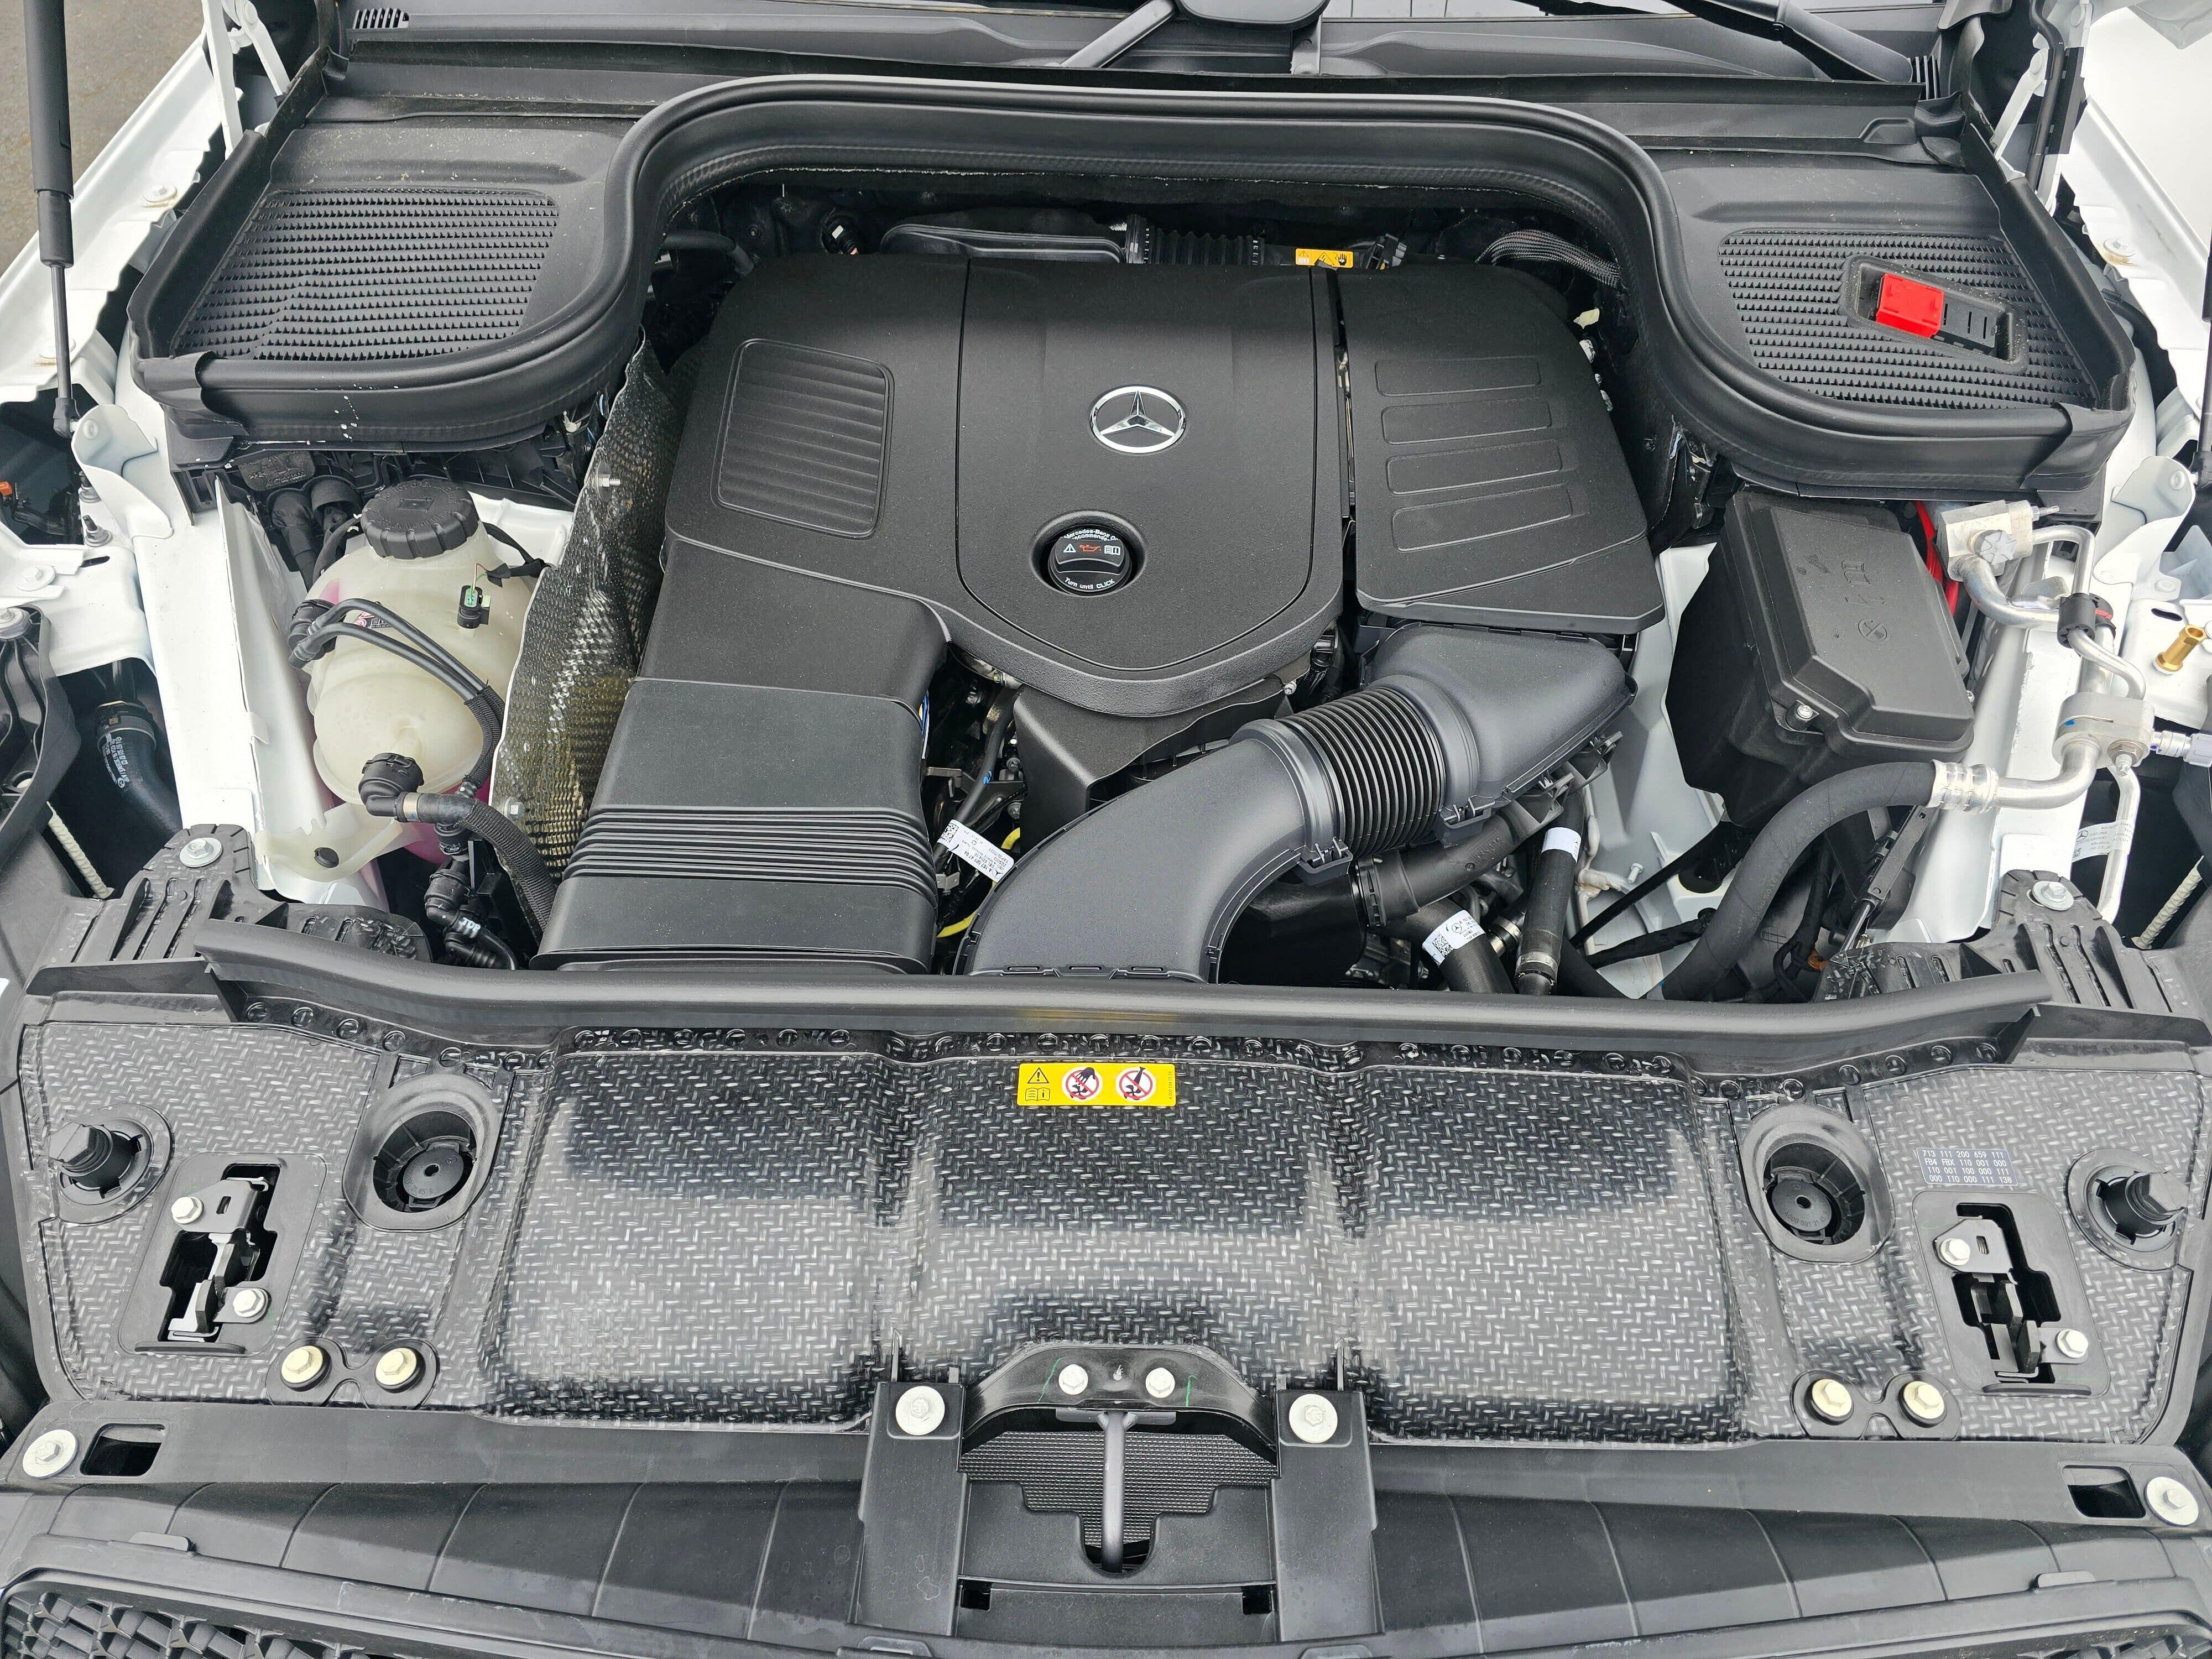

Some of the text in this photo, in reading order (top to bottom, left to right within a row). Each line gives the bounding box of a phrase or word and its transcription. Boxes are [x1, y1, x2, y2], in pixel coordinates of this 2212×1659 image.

[1065, 577, 1078, 587] Turn
[1095, 578, 1115, 589] CLICK
[462, 917, 481, 932] TOP
